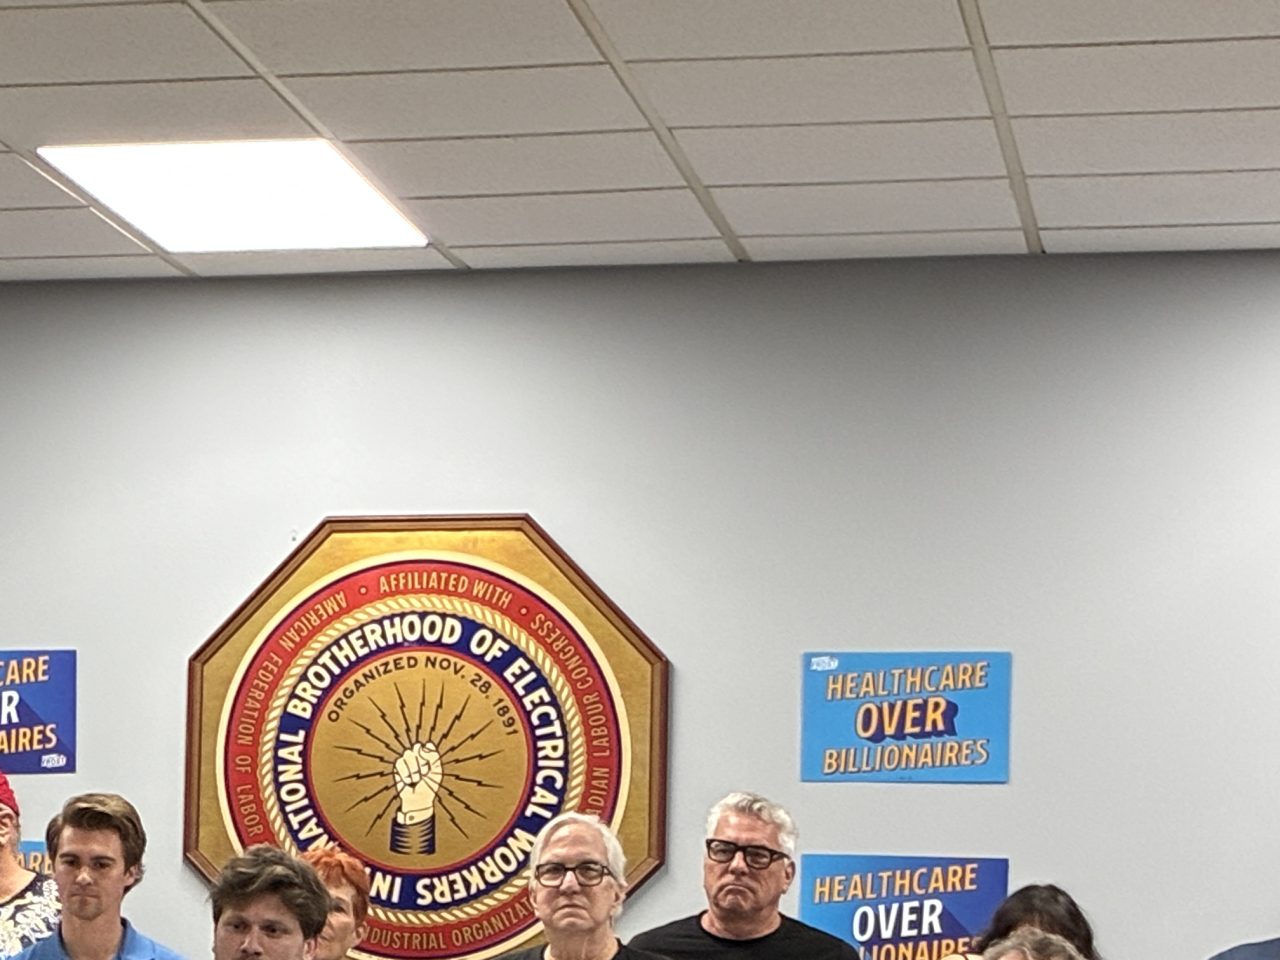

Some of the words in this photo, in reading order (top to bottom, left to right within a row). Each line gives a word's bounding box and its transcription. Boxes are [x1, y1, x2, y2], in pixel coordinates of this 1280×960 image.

[378, 571, 469, 594] AFFILIATED
[472, 579, 513, 609] WITH
[278, 591, 348, 651] AMERICAN
[469, 628, 510, 662] OF
[286, 614, 462, 719] BROTHERHOOD
[530, 613, 593, 690] CONGRESS
[237, 652, 282, 745] FEDERATION
[327, 656, 418, 723] ORGANIZED
[424, 657, 466, 679] NOV.
[492, 698, 519, 736] 1891
[826, 661, 989, 700] HEALTHCARE
[503, 657, 565, 819] ELECTRICAL
[583, 692, 610, 757] LABOUR
[854, 696, 948, 739] OVER
[235, 755, 251, 773] OF
[823, 738, 990, 775] BILLIONAIRES
[236, 785, 264, 837] LABOR
[415, 828, 536, 906] WORKERS
[813, 863, 979, 904] HEALTHCARE
[851, 898, 943, 942] OVER
